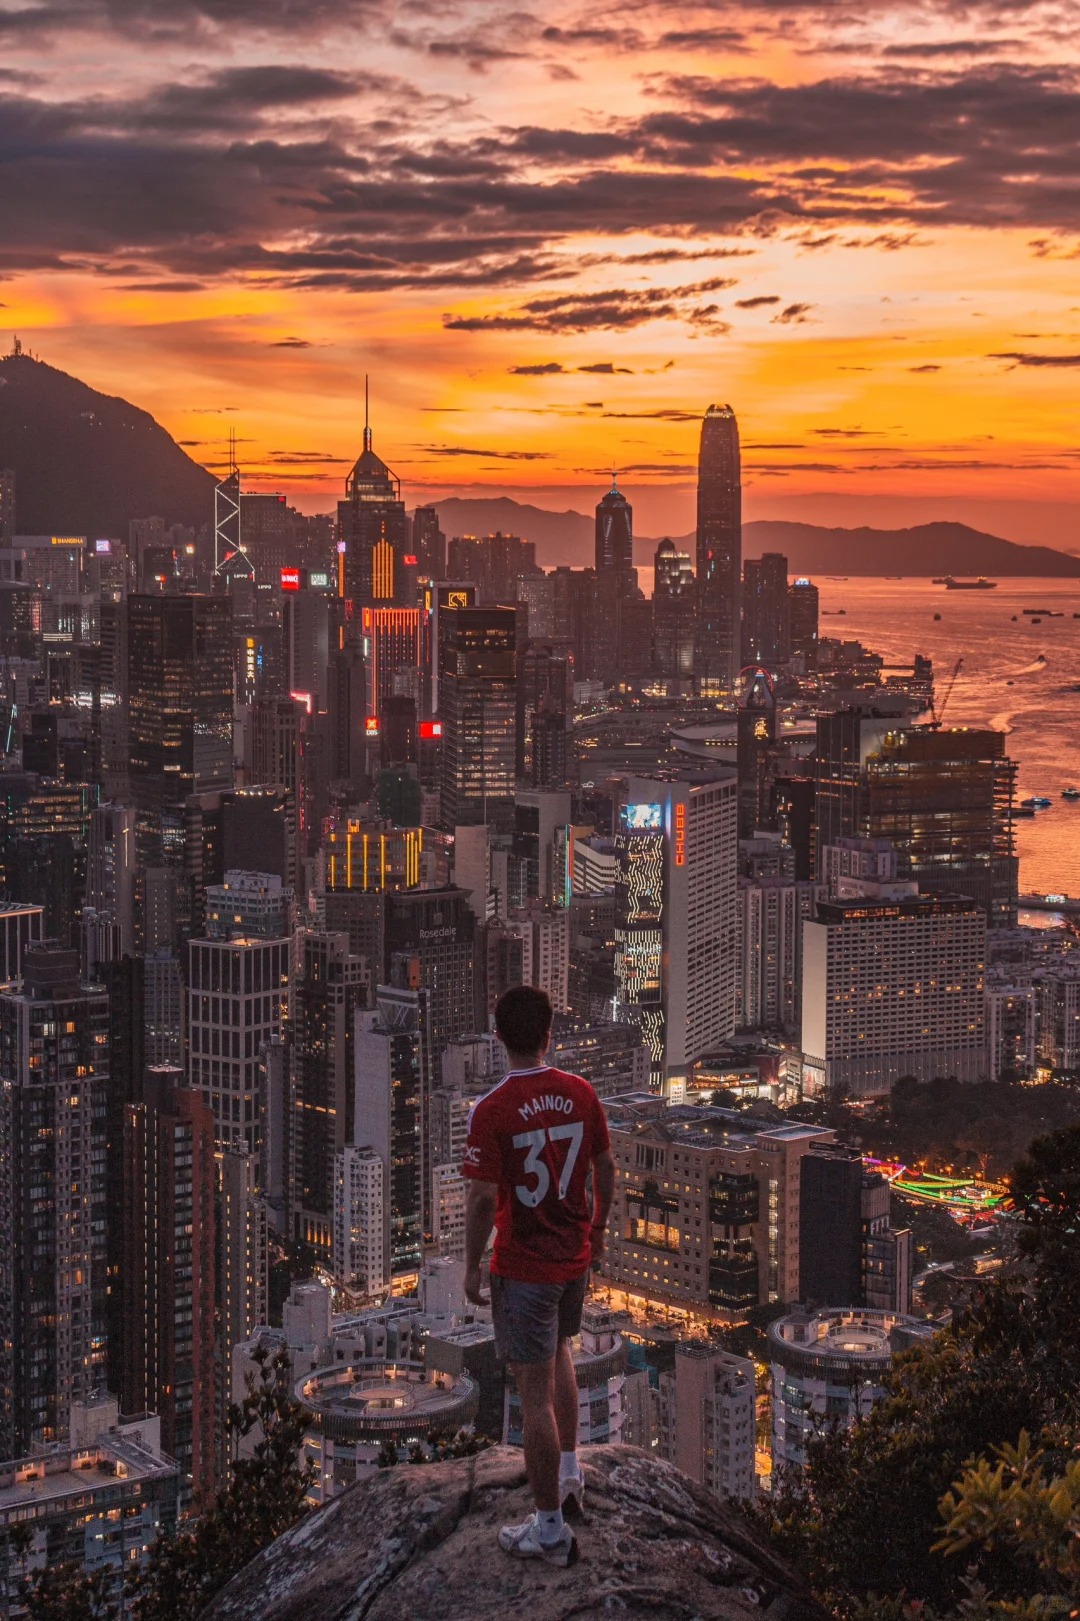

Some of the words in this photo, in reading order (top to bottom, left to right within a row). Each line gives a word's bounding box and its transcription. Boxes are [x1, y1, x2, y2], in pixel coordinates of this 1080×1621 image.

[419, 925, 457, 939] Rosedale
[518, 1094, 574, 1121] MAINOO
[512, 1121, 584, 1208] 37
